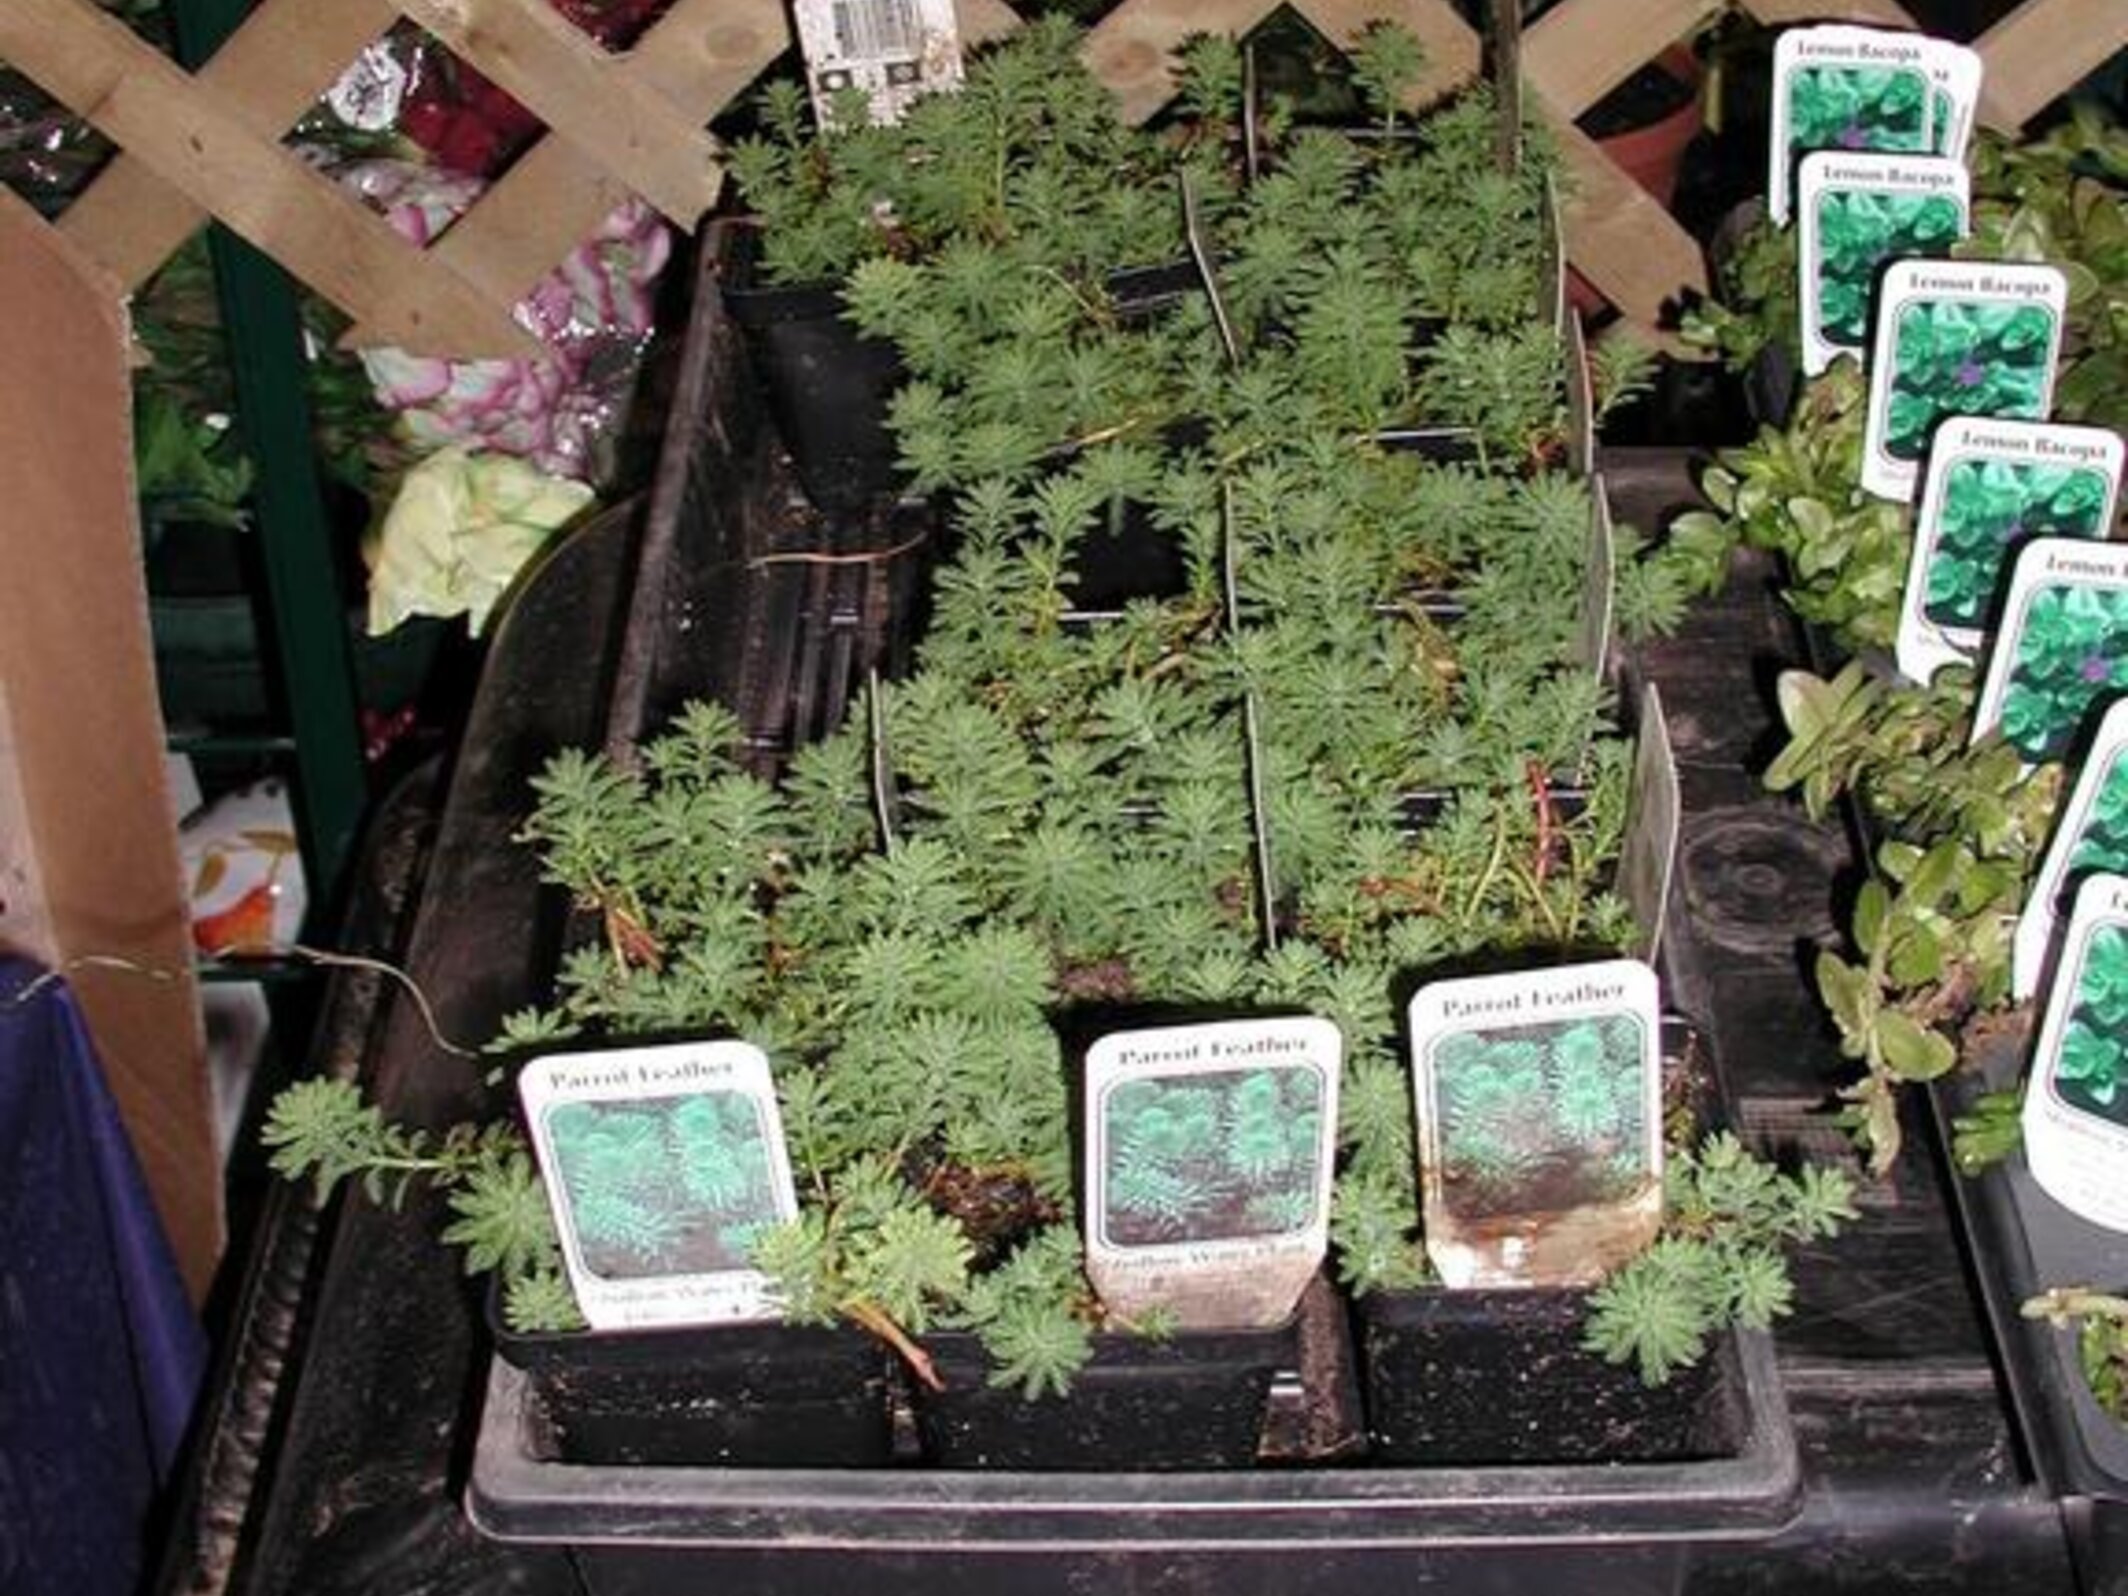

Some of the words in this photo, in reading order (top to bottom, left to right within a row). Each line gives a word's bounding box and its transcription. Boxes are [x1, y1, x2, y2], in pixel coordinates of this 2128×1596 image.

[1797, 41, 1855, 57] Lemon
[1858, 43, 1921, 62] Bacopa
[1823, 165, 1884, 181] Lemon
[1887, 168, 1955, 188] Bacopa
[1909, 273, 1974, 291] Lemon
[1979, 277, 2051, 297] Bacopa
[1961, 429, 2030, 450] Lemon
[2034, 437, 2107, 461] Bacopa
[2046, 553, 2116, 577] Lemon
[1442, 993, 1522, 1017] Parrot
[1532, 983, 1624, 1005] Feather
[1119, 1044, 1198, 1065] Parrot
[1210, 1036, 1306, 1057] Feather
[550, 1068, 629, 1089] Parrot
[638, 1062, 733, 1083] Feather
